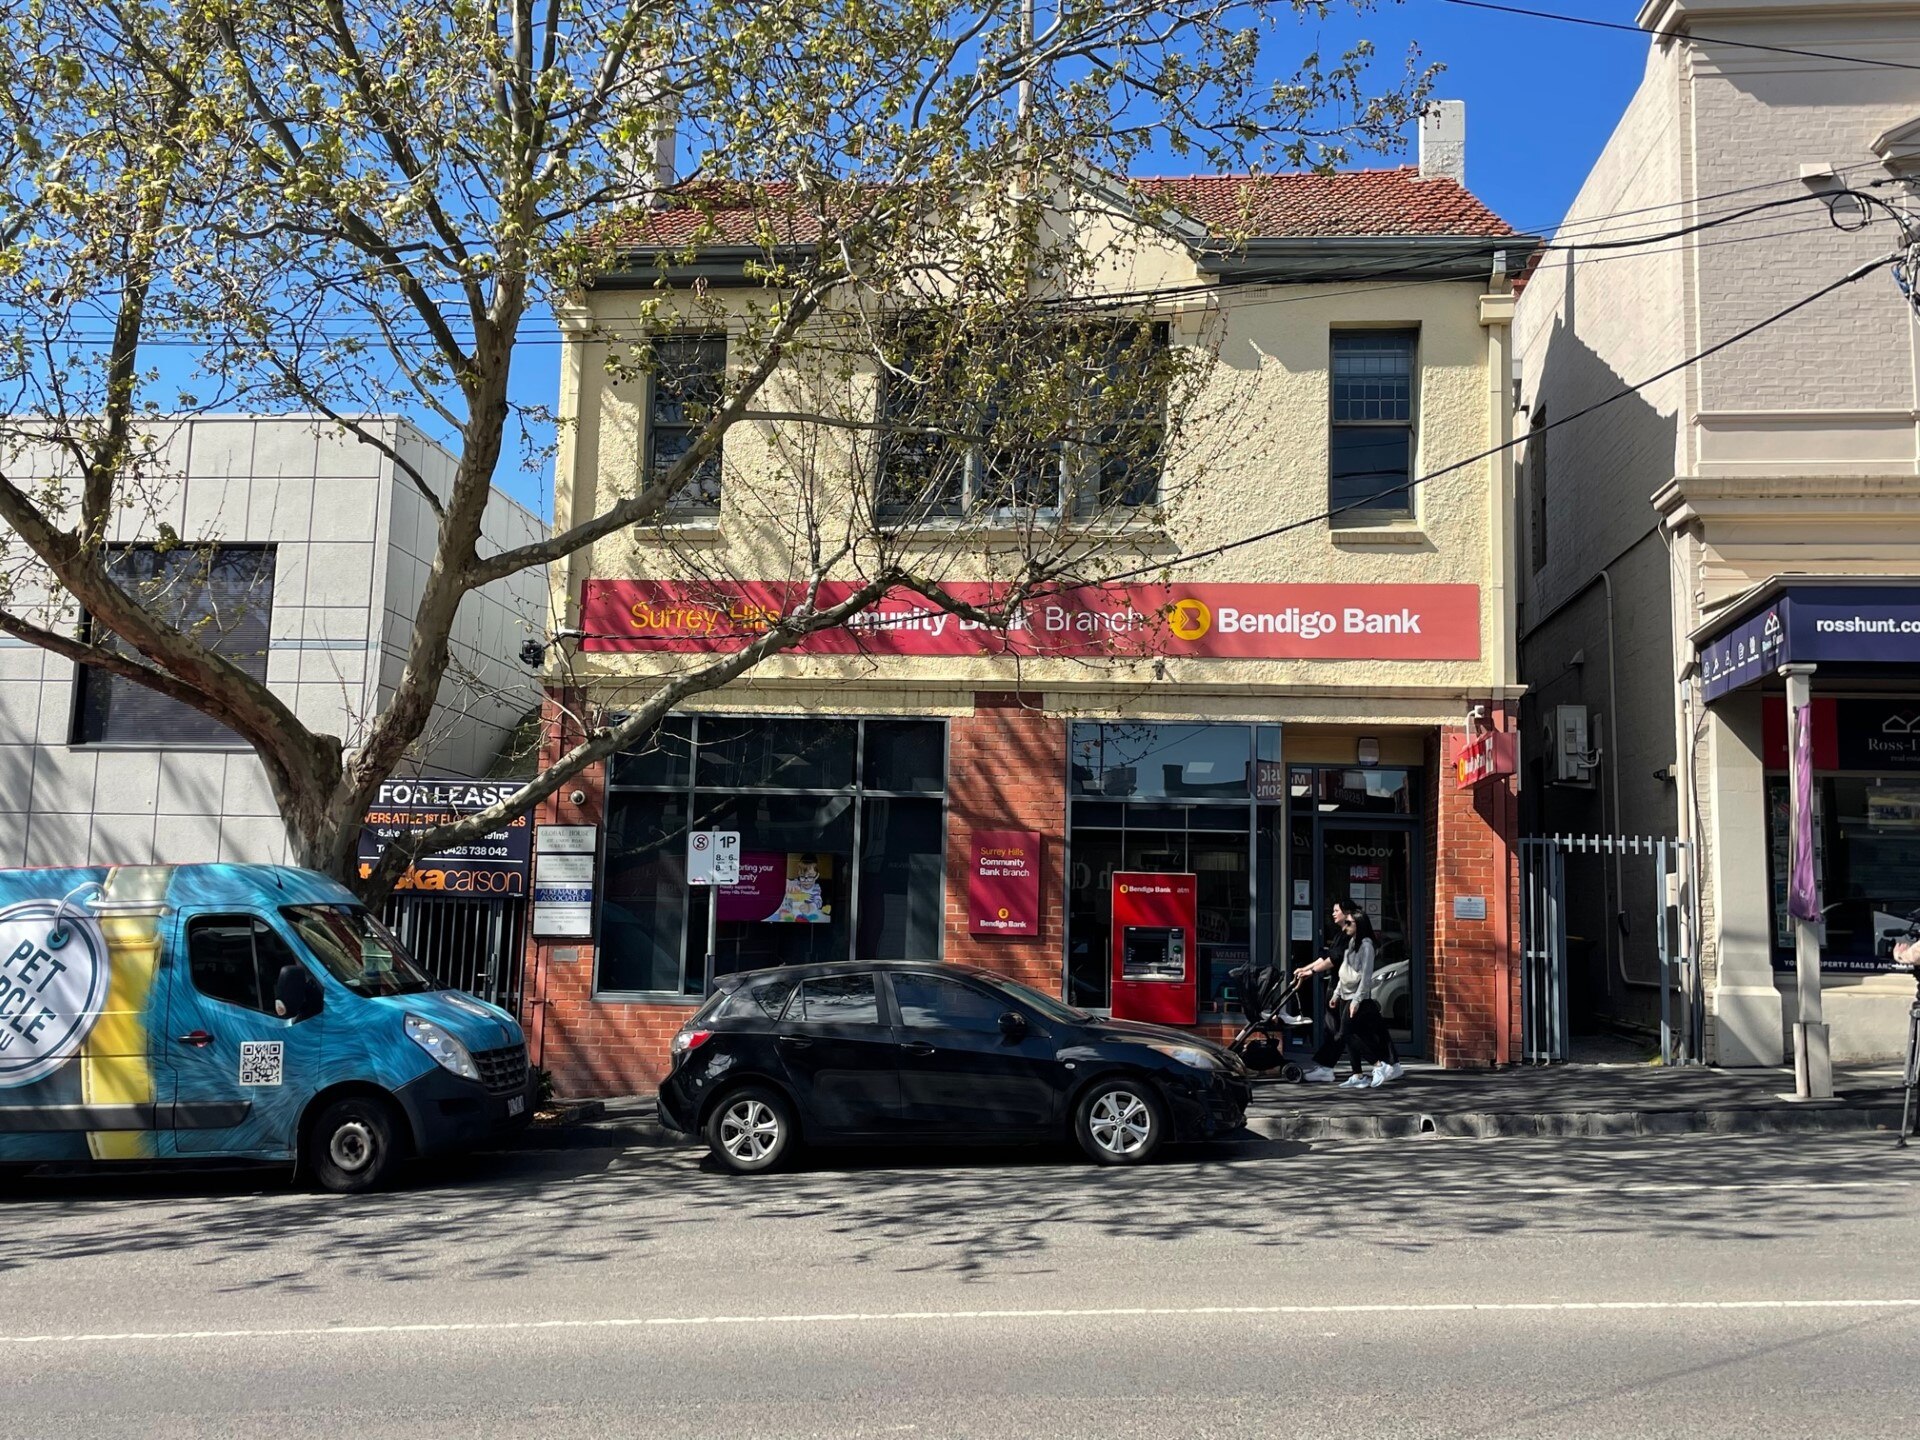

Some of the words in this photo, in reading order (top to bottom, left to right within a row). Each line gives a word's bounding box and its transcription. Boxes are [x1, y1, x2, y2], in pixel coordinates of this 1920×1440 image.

[631, 602, 718, 636] Surrey
[791, 604, 948, 636] Cmunity
[1045, 606, 1144, 632] Branch
[1218, 608, 1337, 639] Bendigo
[1343, 608, 1421, 634] Bank
[1816, 616, 1920, 633] rosshunt.co
[379, 785, 428, 803] FOR
[434, 786, 513, 806] LEASE
[719, 836, 737, 848] 1P
[469, 847, 487, 857] 738
[488, 848, 508, 857] 042
[980, 847, 1006, 858] Surrey
[1008, 848, 1025, 856] Hills
[980, 857, 1025, 868] Community
[980, 867, 1001, 876] Bank
[1002, 868, 1030, 877] Branch
[1129, 885, 1154, 894] Bendigo
[980, 920, 1008, 929] Bendigo
[1008, 920, 1027, 928] Bank
[3, 939, 67, 993] PET
[1850, 961, 1875, 969] SALES
